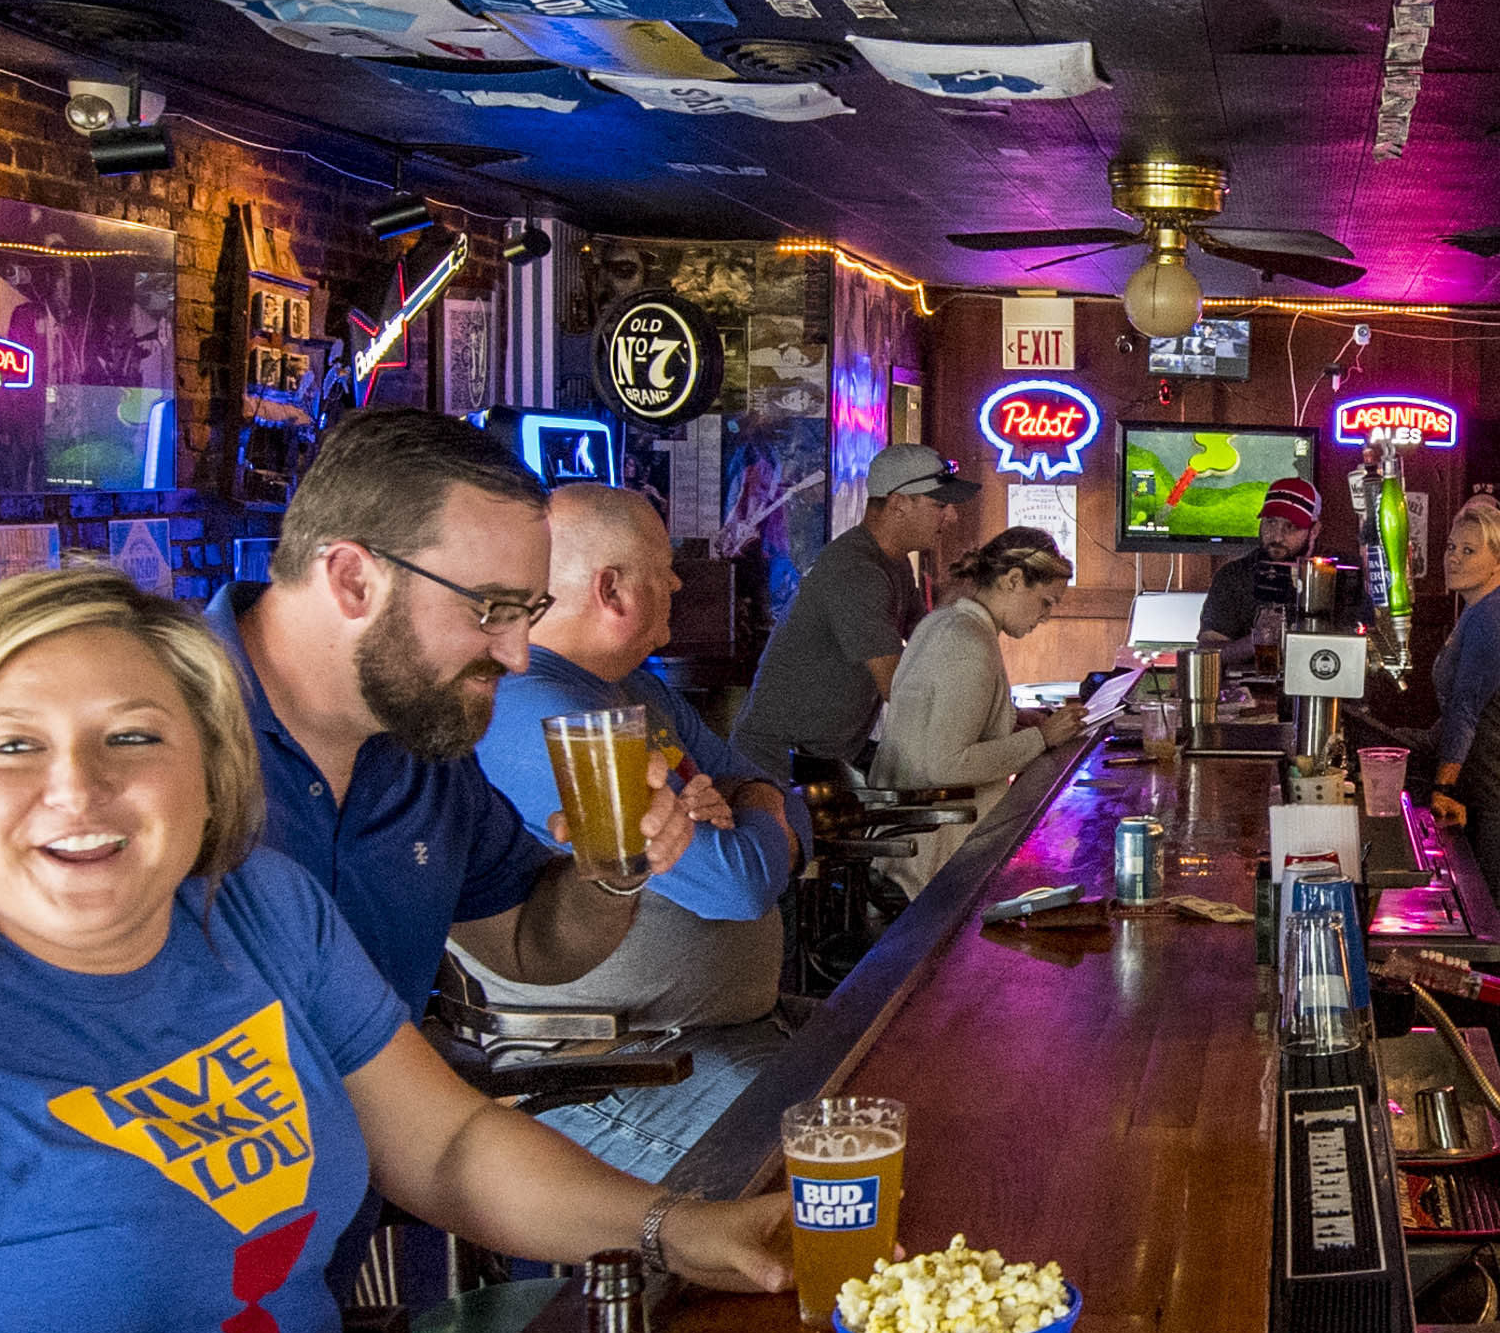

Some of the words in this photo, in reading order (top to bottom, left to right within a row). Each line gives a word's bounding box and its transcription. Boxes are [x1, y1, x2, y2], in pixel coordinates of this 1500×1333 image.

[630, 318, 663, 332] OLD
[648, 336, 682, 389] 7
[1017, 329, 1064, 365] EXIT
[625, 387, 670, 406] BRAND
[1002, 400, 1084, 438] Pabst
[1342, 405, 1451, 433] LAGUNITAS
[1370, 426, 1422, 444] ALES
[103, 1032, 275, 1132] LIVE
[148, 1079, 299, 1164] LIKE
[188, 1129, 310, 1202] LOU
[803, 1182, 864, 1207] BUD
[796, 1200, 874, 1227] LIGHT
